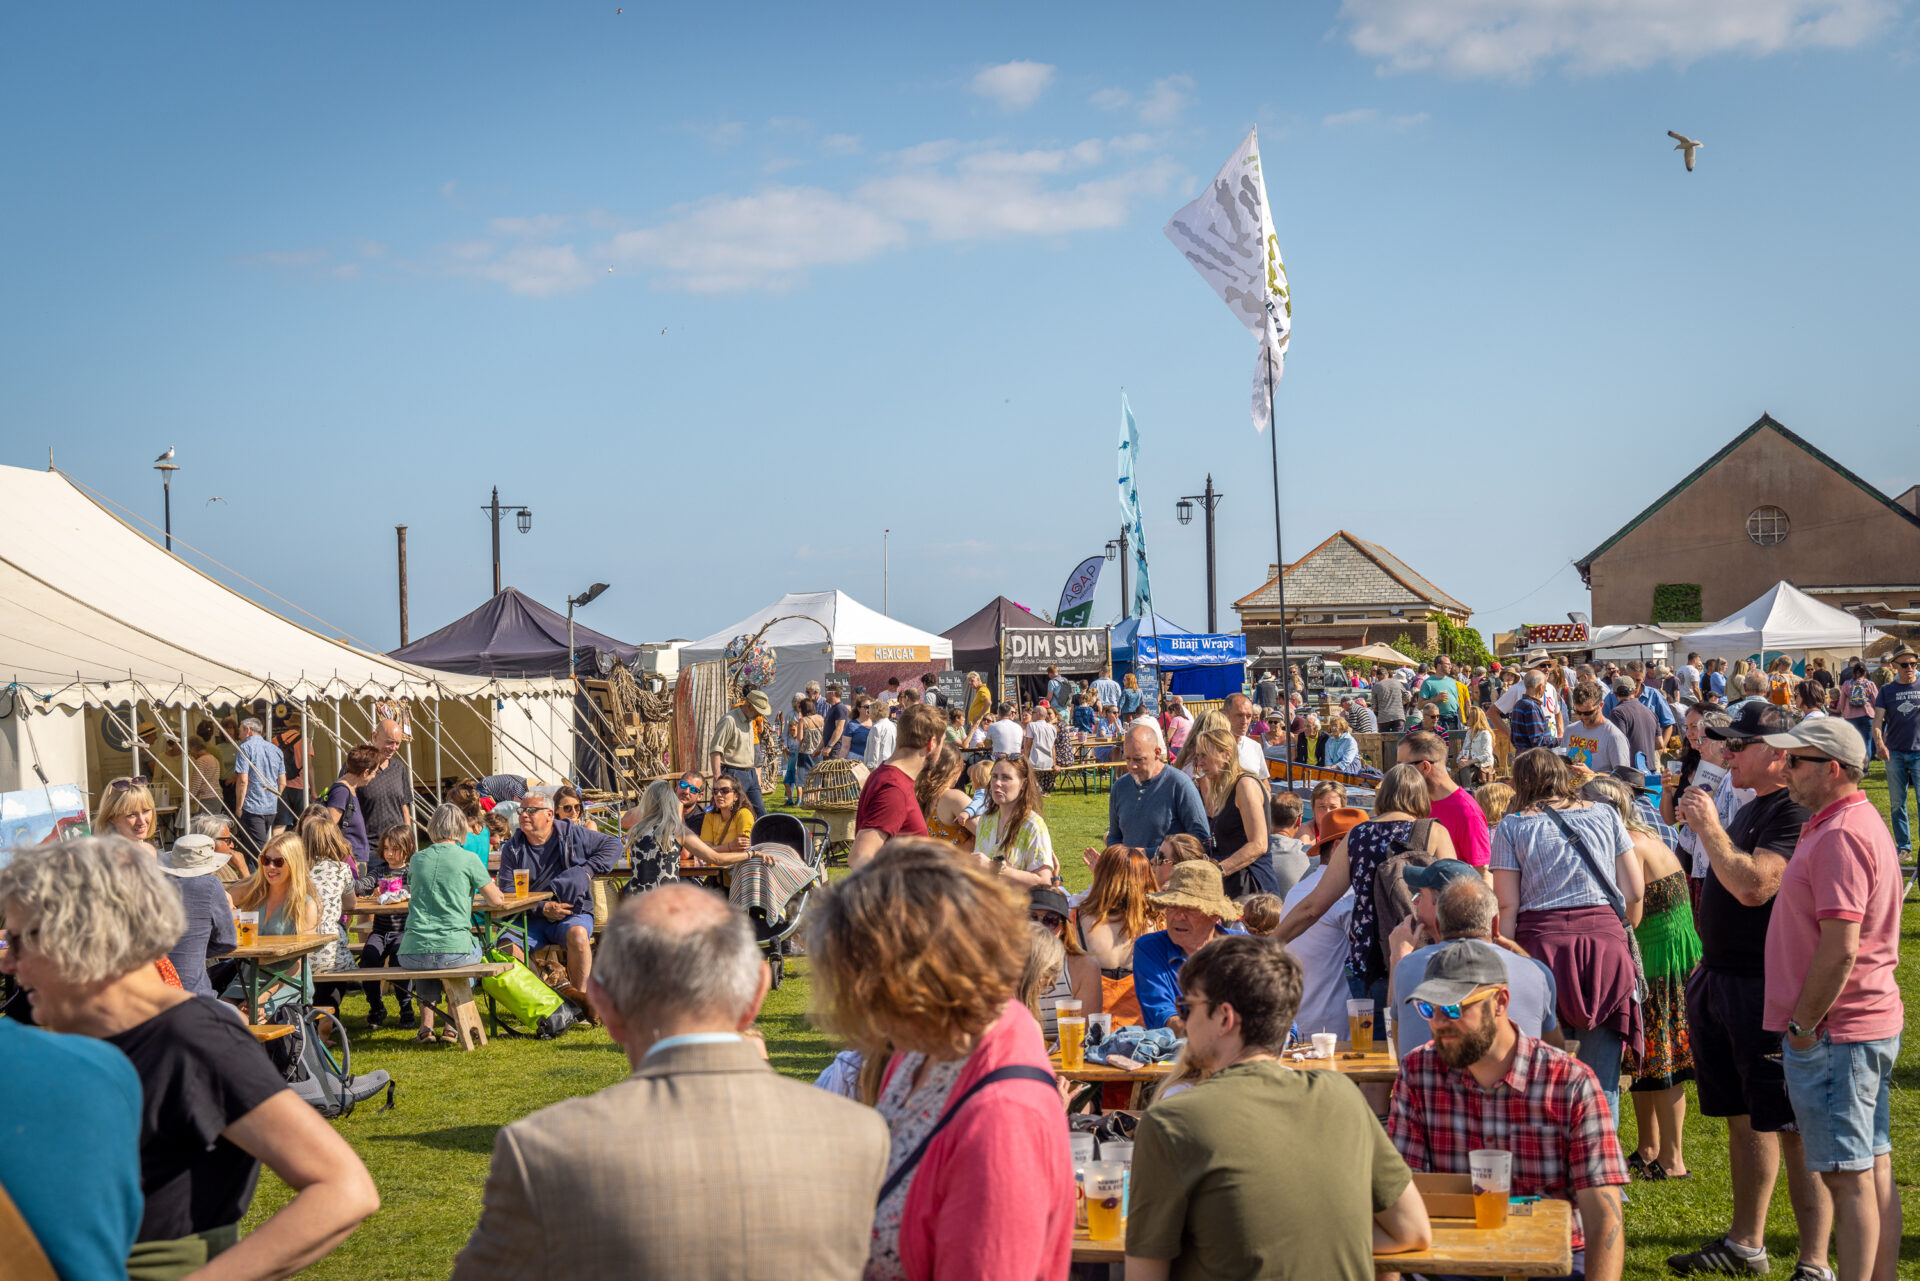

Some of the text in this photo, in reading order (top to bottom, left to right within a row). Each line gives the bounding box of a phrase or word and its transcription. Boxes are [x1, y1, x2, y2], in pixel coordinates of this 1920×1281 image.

[1529, 624, 1588, 644] PIZZA
[1011, 634, 1099, 658] DIM SUM
[1171, 638, 1234, 651] Bhaji Wraps
[875, 647, 914, 660] MEXICAN
